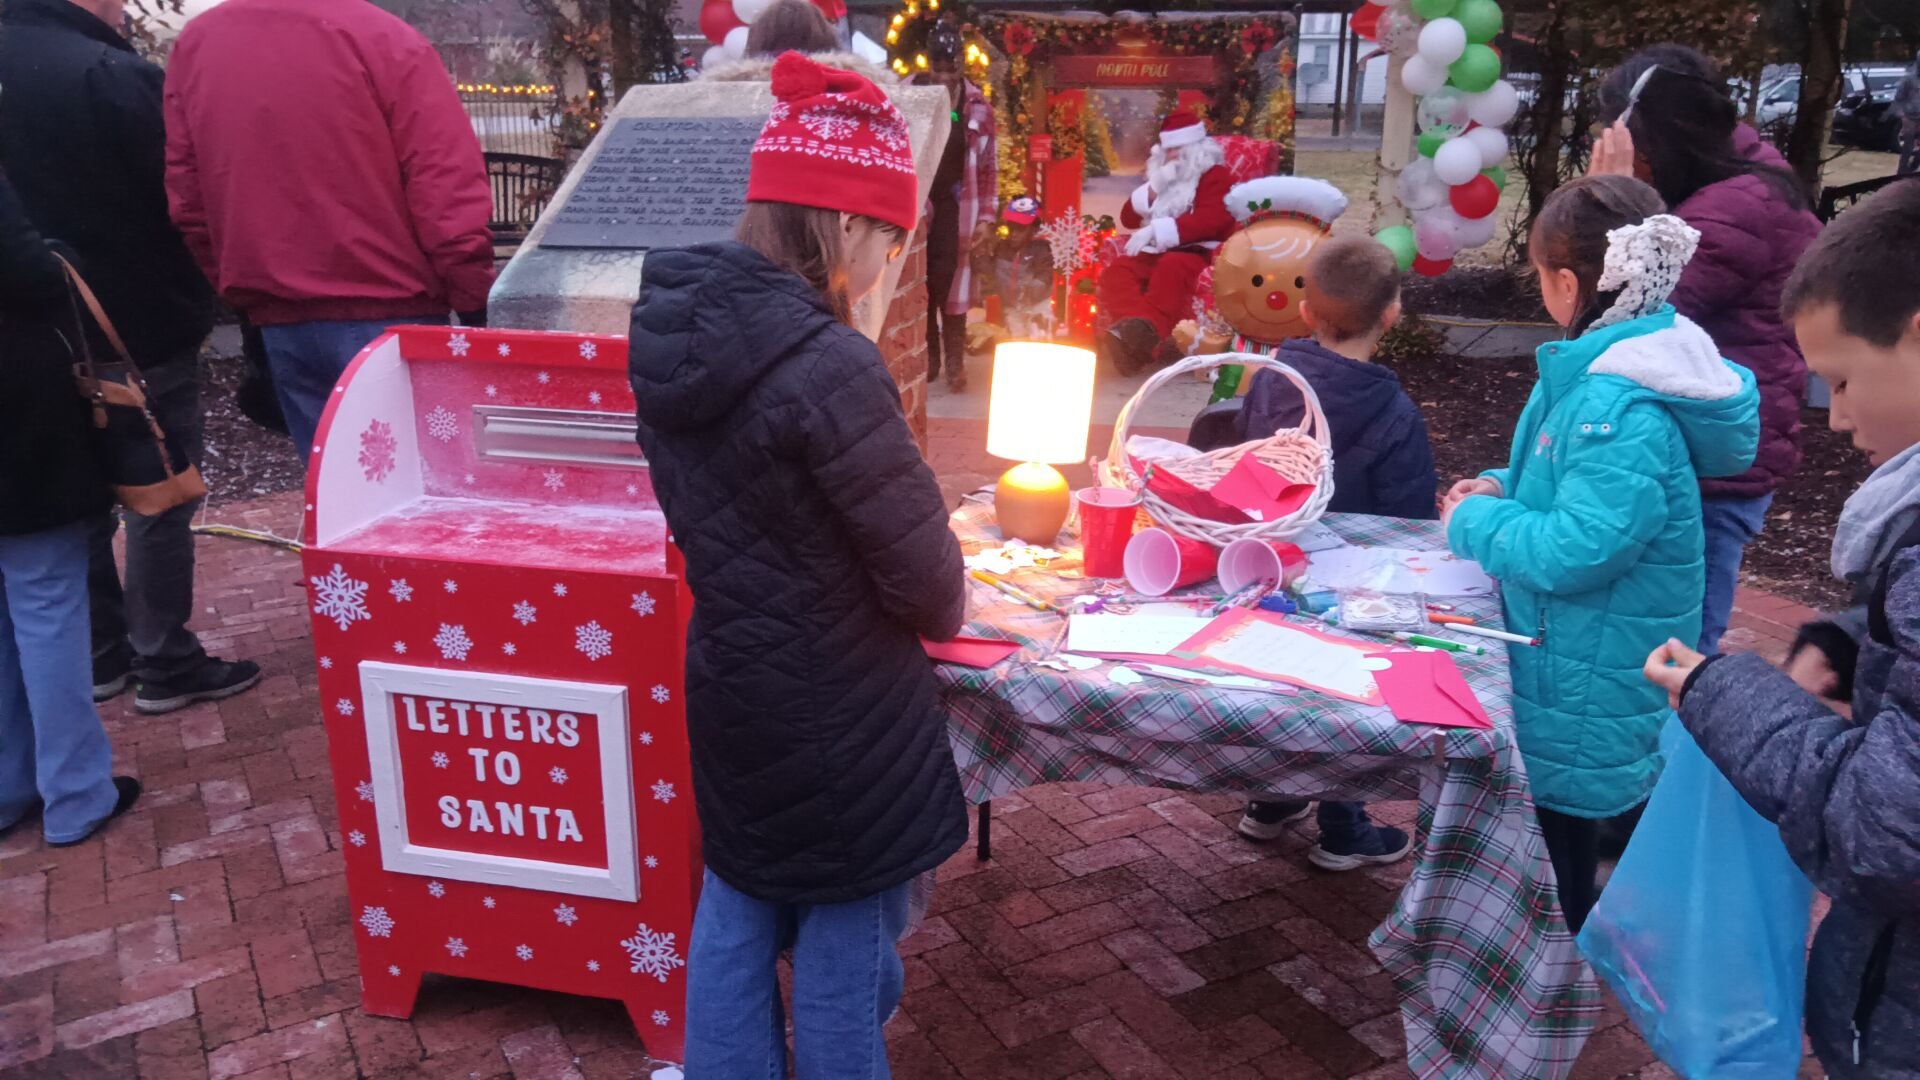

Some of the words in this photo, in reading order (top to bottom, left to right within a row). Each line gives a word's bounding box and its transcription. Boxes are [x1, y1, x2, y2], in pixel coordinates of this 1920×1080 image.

[1096, 63, 1137, 77] NORTH
[1140, 63, 1169, 78] POLE
[402, 696, 580, 747] LETTERS
[467, 747, 521, 786] TO
[438, 795, 583, 842] SANTA
